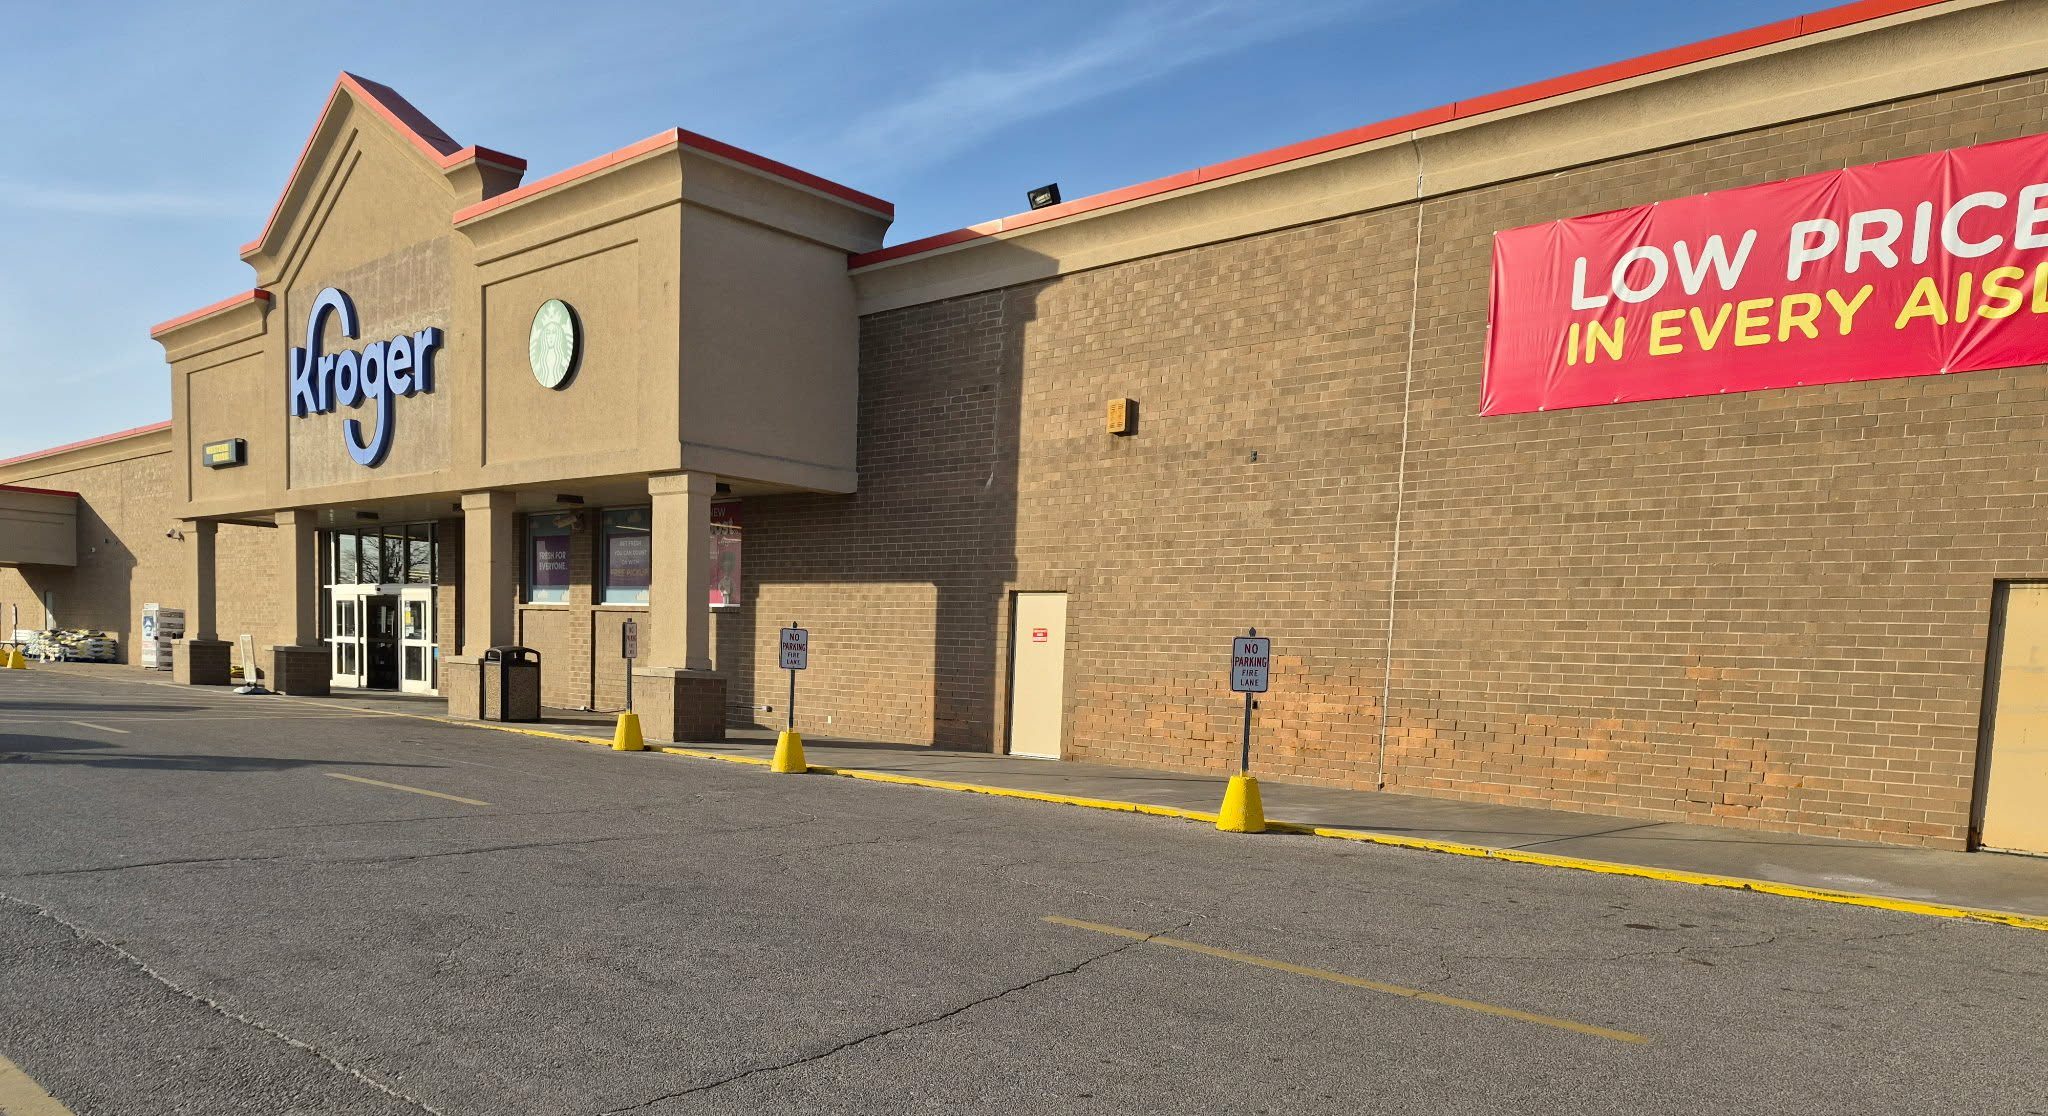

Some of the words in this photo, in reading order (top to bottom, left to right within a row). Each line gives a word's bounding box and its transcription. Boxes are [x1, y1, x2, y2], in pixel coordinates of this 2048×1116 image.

[1571, 229, 1757, 312] LOW
[1786, 182, 2048, 282] PRICE
[1567, 317, 1625, 366] IN
[1648, 284, 1874, 357] EVERY
[290, 286, 443, 469] Kroger
[539, 551, 554, 560] FRESH
[555, 551, 567, 560] FOR
[790, 633, 800, 641] NO
[783, 642, 806, 651] PARKING
[1244, 643, 1259, 654] NO
[1234, 656, 1267, 667] PARKING
[1241, 669, 1259, 677] FIRE
[1240, 678, 1259, 686] LANE
